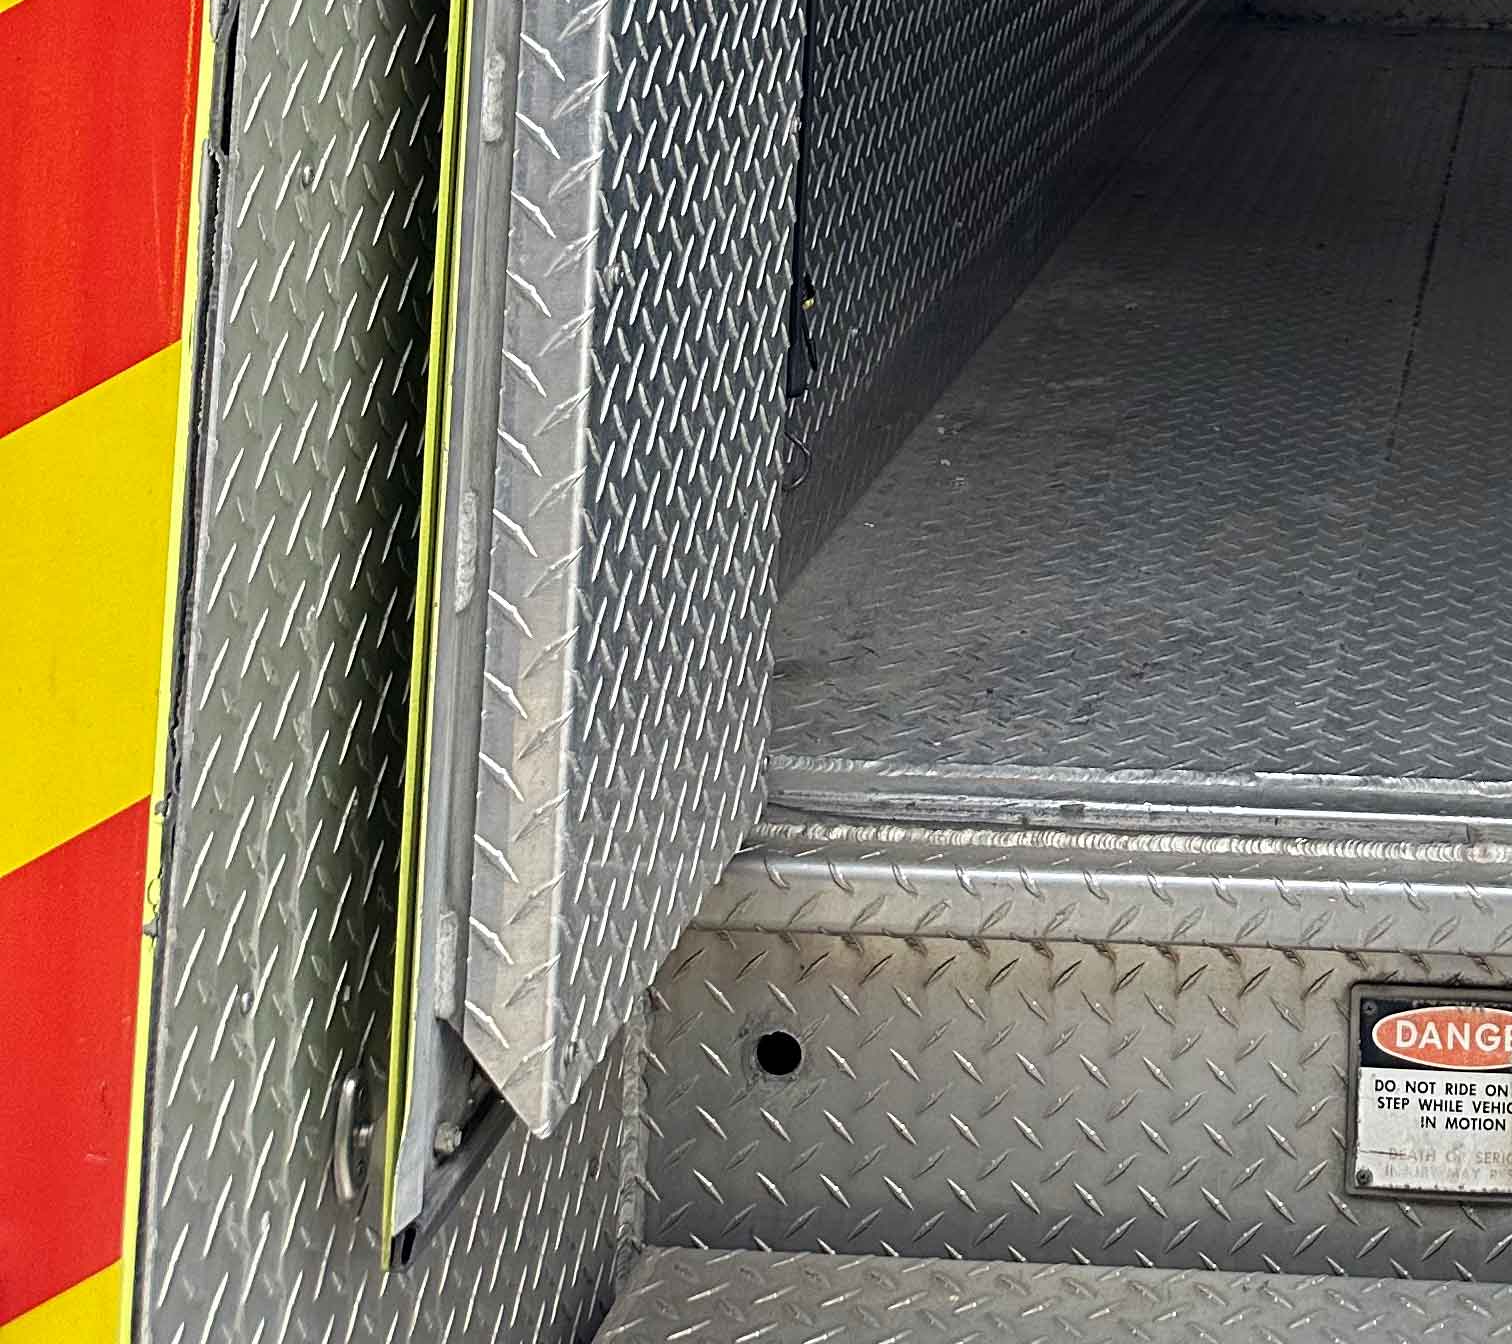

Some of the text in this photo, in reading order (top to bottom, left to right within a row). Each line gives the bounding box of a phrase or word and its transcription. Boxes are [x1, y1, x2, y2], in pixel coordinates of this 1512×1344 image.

[1375, 1079, 1396, 1092] DO
[1405, 1080, 1436, 1094] NOT
[1445, 1082, 1477, 1096] RIDE
[1485, 1084, 1508, 1097] ON
[1377, 1096, 1410, 1110] STEP
[1418, 1097, 1464, 1112] WHILE
[1421, 1115, 1506, 1131] IN MOTION
